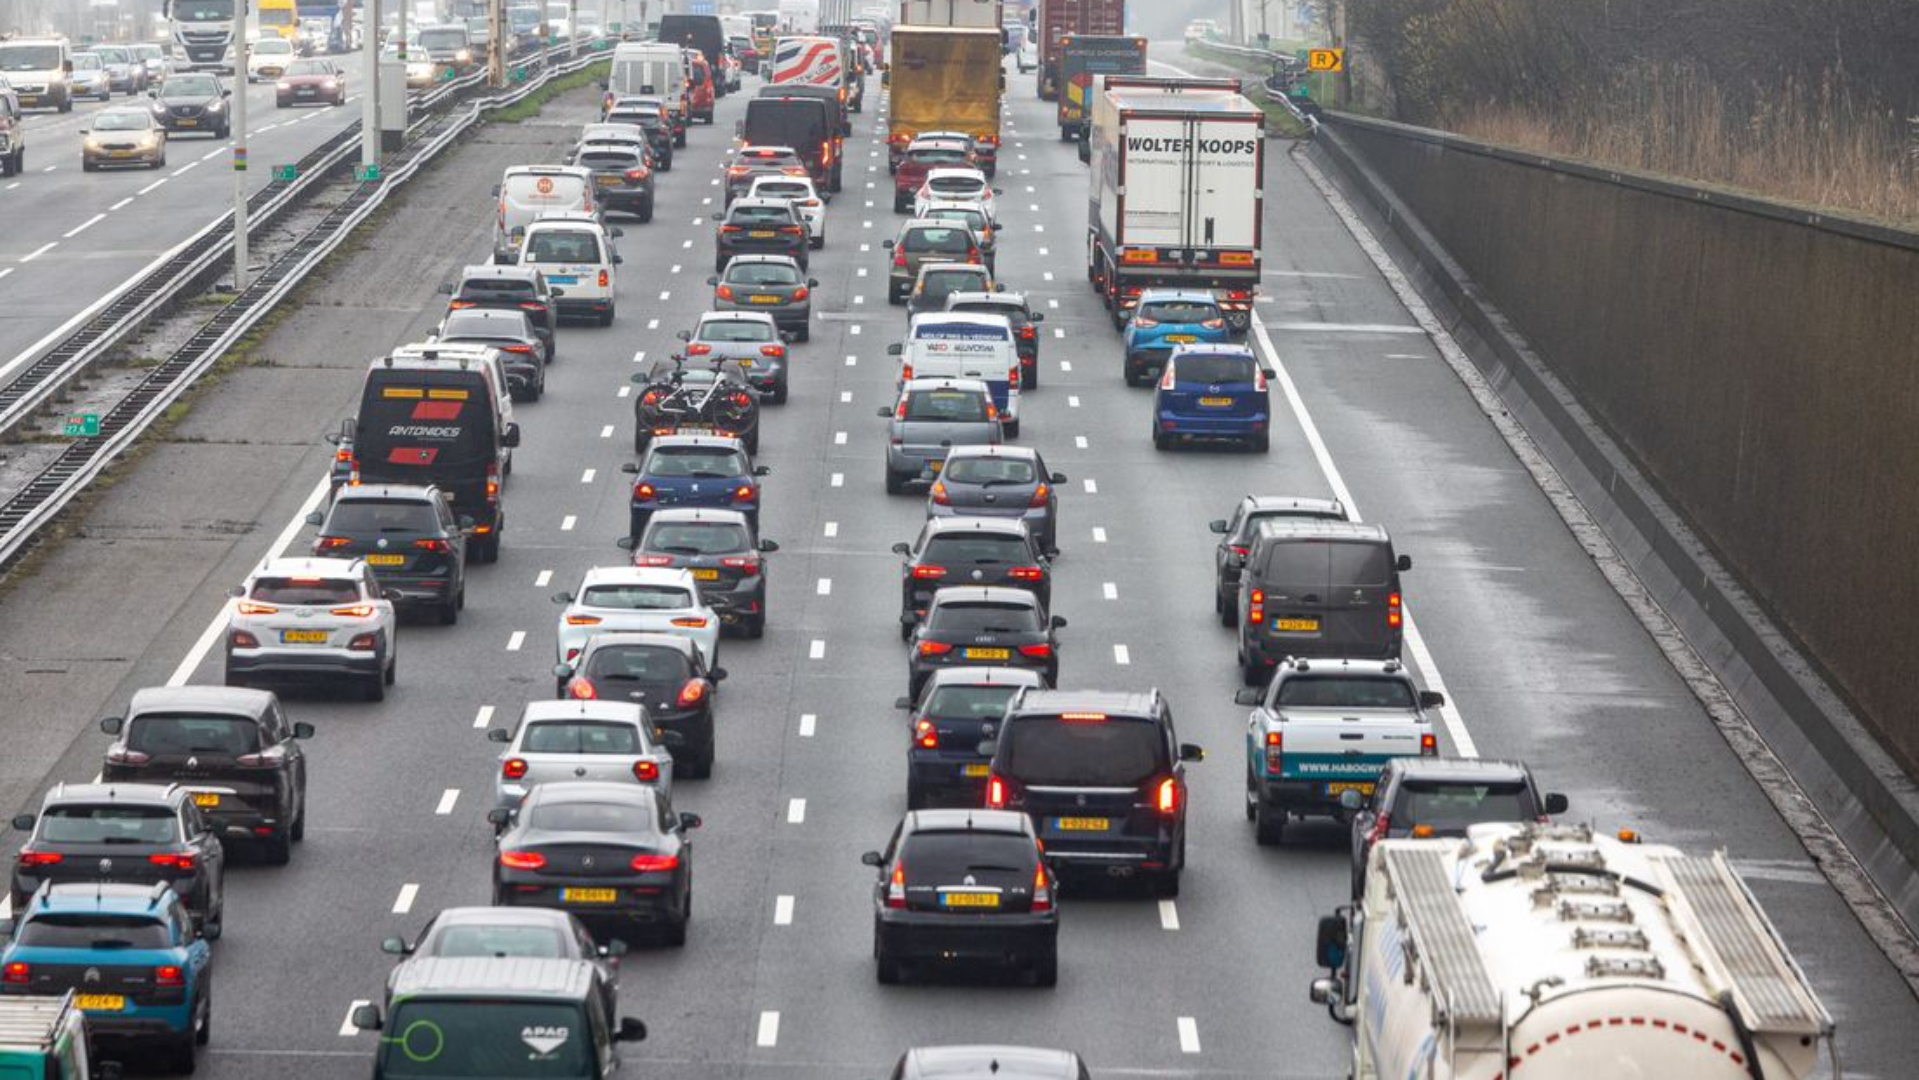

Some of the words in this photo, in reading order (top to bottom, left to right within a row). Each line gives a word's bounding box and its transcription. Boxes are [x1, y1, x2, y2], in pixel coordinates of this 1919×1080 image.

[1316, 53, 1326, 65] R
[1127, 138, 1192, 152] WOLTER
[1198, 139, 1256, 154] KOOPS
[388, 425, 462, 437] ANTONIDES
